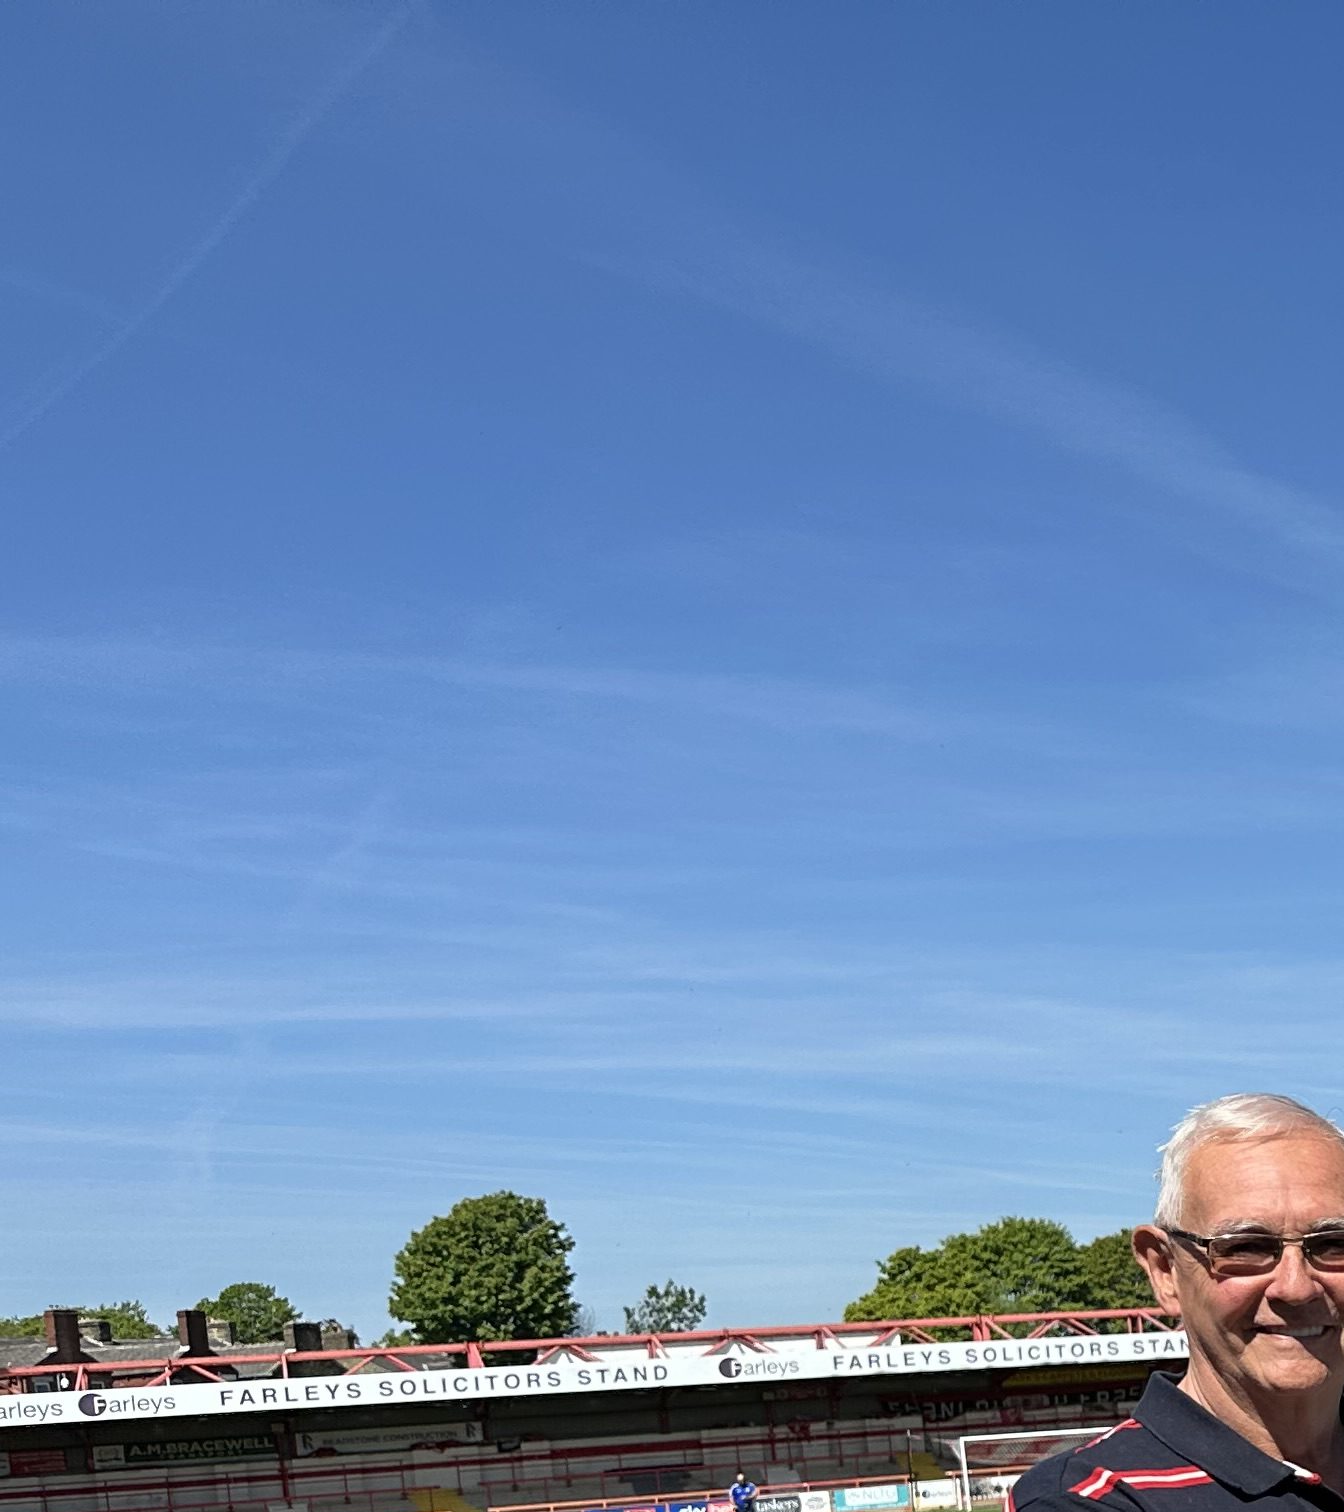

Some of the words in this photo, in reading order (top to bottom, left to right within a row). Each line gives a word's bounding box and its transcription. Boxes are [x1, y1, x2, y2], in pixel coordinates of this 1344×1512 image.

[833, 1350, 952, 1371] FARLEYS
[965, 1341, 1120, 1363] SOLICITORS
[1133, 1337, 1188, 1355] STAN
[220, 1383, 362, 1406] FARLEYS
[379, 1371, 562, 1397] SOLICITORS
[577, 1365, 669, 1386] STAND
